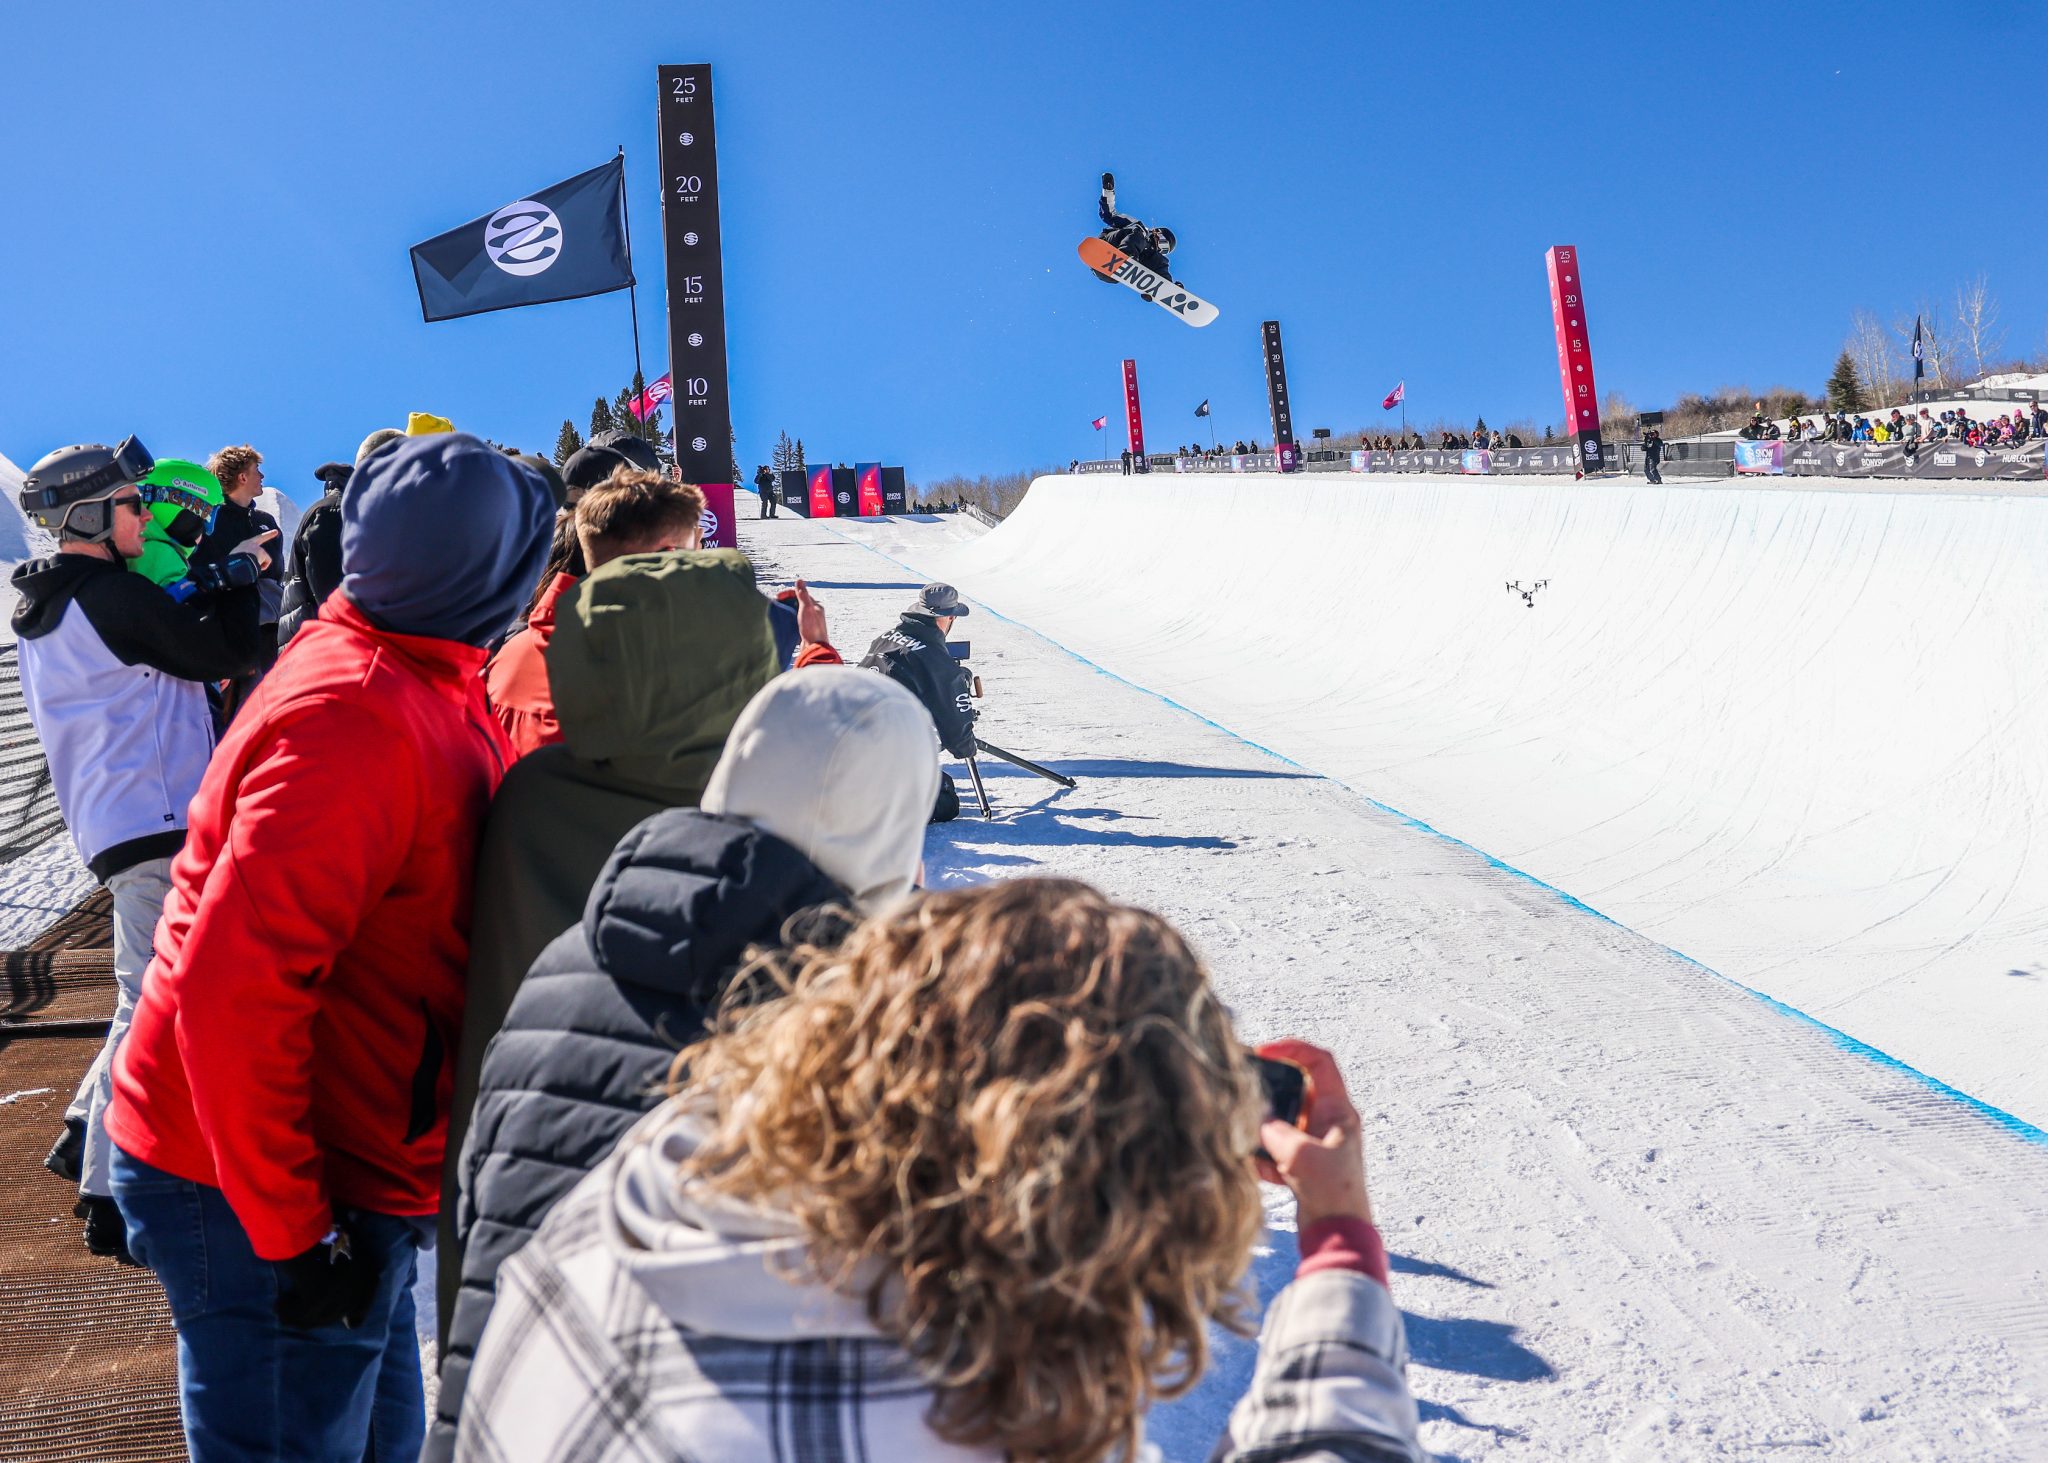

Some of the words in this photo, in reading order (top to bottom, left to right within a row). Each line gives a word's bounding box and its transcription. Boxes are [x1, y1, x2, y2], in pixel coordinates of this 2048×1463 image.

[672, 77, 696, 94] 25
[676, 175, 702, 193] 20
[1559, 251, 1571, 260] 25
[1101, 254, 1164, 297] YONEX
[683, 275, 703, 294] 15
[1564, 294, 1577, 304] 20
[1572, 339, 1582, 348] 15
[686, 377, 708, 396] 10
[1578, 384, 1588, 393] 10
[1755, 448, 1774, 458] SNOW
[2002, 454, 2031, 463] HUBLOT
[881, 630, 927, 651] CREW
